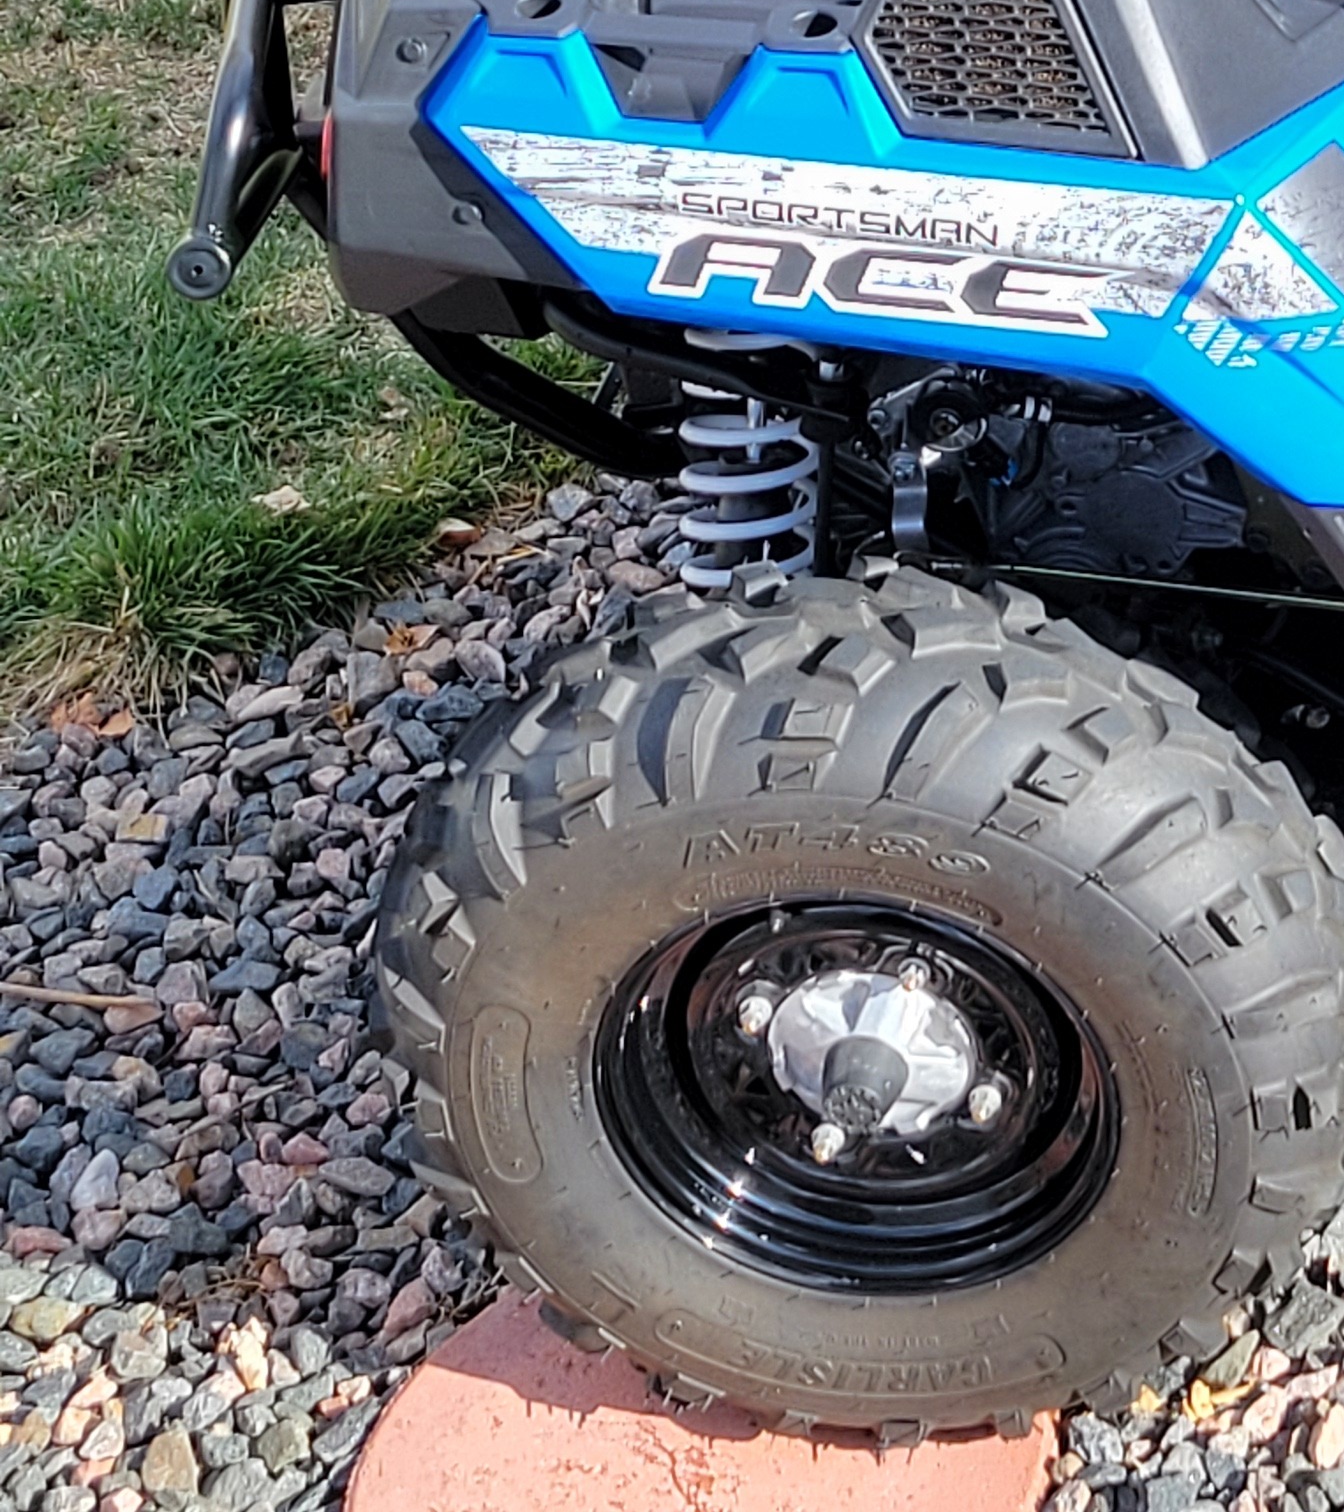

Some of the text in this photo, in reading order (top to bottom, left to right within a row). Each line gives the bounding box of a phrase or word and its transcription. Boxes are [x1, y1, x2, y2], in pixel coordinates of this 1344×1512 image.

[679, 190, 998, 246] SPORTSMAN
[655, 232, 1114, 332] ACE
[724, 1338, 992, 1394] CARLISLE
